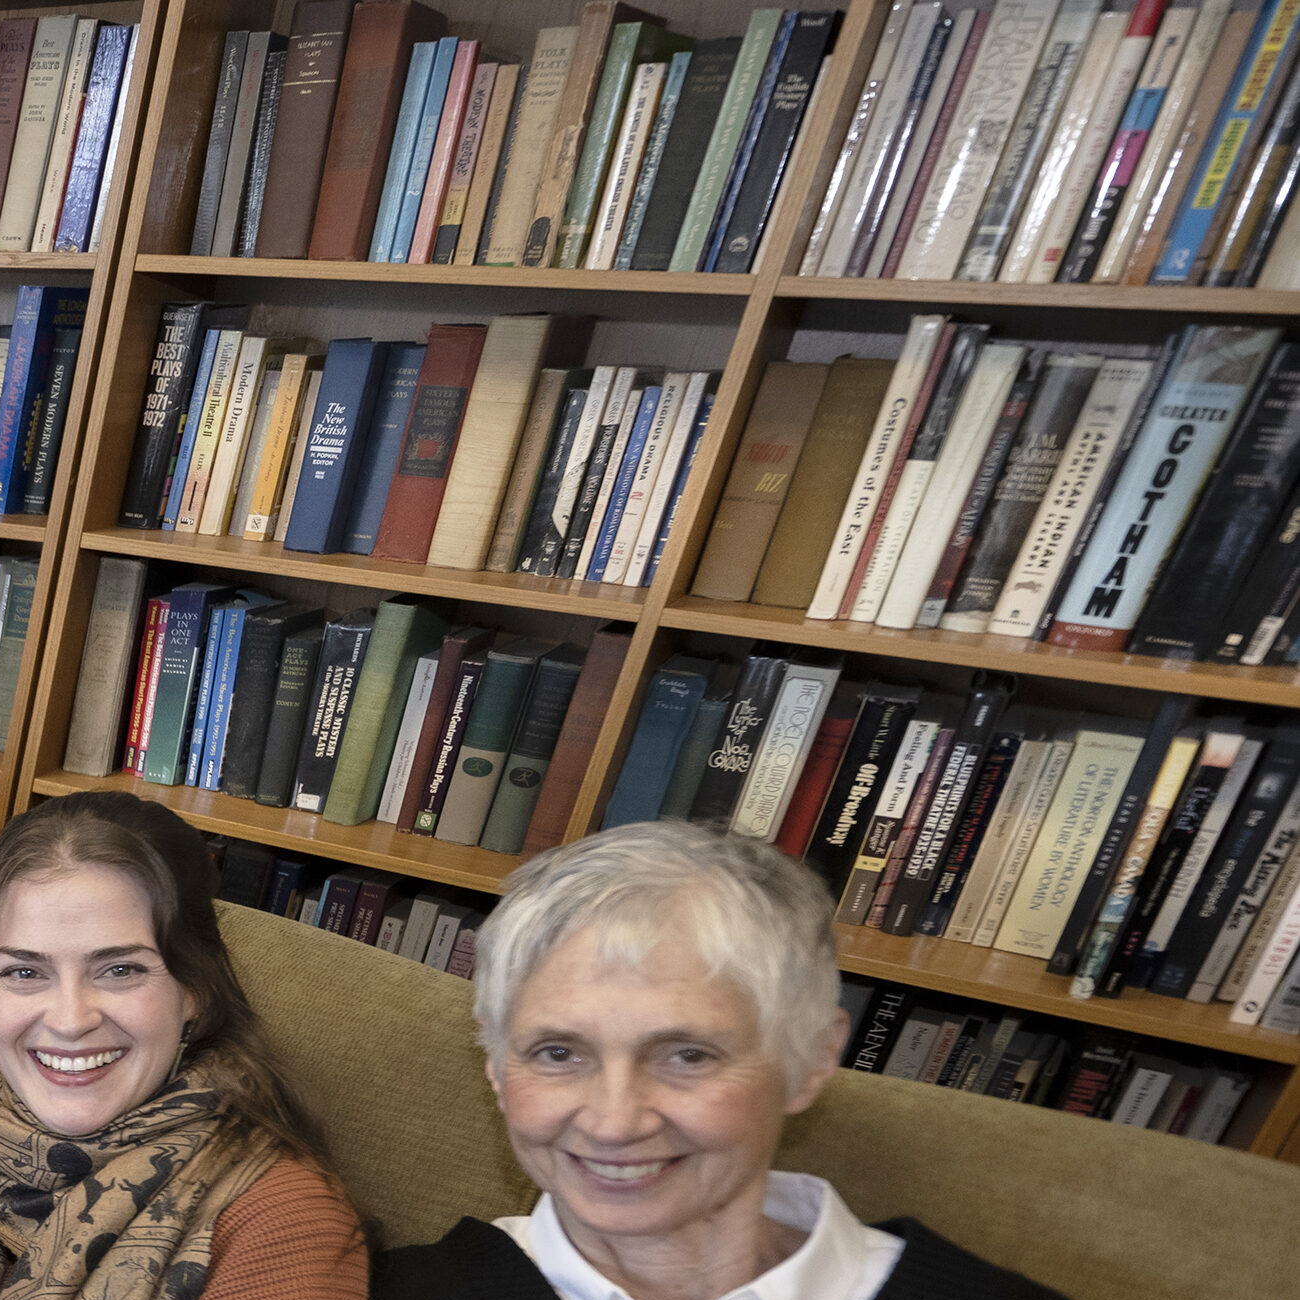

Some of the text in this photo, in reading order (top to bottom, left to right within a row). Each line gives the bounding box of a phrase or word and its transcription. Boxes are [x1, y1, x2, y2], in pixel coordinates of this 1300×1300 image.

[75, 31, 87, 57] Drama
[30, 61, 60, 70] PLAYS
[71, 66, 79, 79] the
[63, 81, 76, 110] Modern
[58, 111, 70, 134] World
[164, 325, 186, 342] THE
[156, 343, 185, 360] BEST
[3, 336, 30, 406] AMERICAN
[151, 360, 182, 378] PLAYS
[211, 341, 233, 401] Multicultural
[155, 377, 169, 394] OF
[147, 393, 173, 411] 1971-
[203, 399, 220, 430] Theatre
[224, 362, 254, 443] Modern Drama
[327, 401, 346, 414] The
[652, 384, 676, 441] RELIGIOUS
[32, 363, 65, 484] SEVEN MODERN PLAYS
[142, 410, 165, 428] 1972
[313, 424, 348, 436] British
[320, 413, 345, 425] New
[310, 434, 345, 446] Drama
[618, 454, 638, 497] ANTHOLOGY
[638, 444, 657, 482] DRAMA
[837, 394, 908, 558] Costumes of the East
[754, 472, 788, 493] BIZ
[1037, 430, 1105, 571] AMERICAN INDIAN
[606, 507, 620, 535] ROMAN
[1082, 422, 1195, 620] GOTHAM
[598, 534, 613, 560] DRAMA
[169, 610, 199, 621] PLAYS
[177, 619, 189, 630] IN
[229, 611, 238, 627] The
[144, 640, 152, 653] Best
[170, 636, 190, 646] ACT
[171, 628, 192, 638] ONE
[226, 628, 235, 645] Best
[284, 658, 310, 666] PLAYS
[349, 632, 363, 664] RICHARDS
[140, 654, 150, 682] American
[145, 632, 164, 717] The Best American Short Plays
[219, 647, 232, 683] American
[137, 682, 145, 697] Short
[217, 682, 226, 702] Short
[317, 682, 329, 707] MODERN
[134, 697, 143, 713] Plays
[212, 703, 223, 723] Plays
[313, 664, 344, 758] AND SUSPENSE PLAYS
[324, 666, 355, 758] 10 CLASSIC MYSTERY
[727, 702, 764, 731] Lyrics
[741, 698, 758, 716] The
[310, 707, 323, 736] THEATRE
[426, 672, 475, 795] Nineteenth-Century Russian Plays
[734, 726, 746, 744] of
[187, 752, 197, 781] APPLAUSE
[204, 758, 214, 788] APPLAUSE
[751, 681, 819, 837] THE NOEL COWARD DIARIES
[885, 722, 929, 815] Feeling And Form
[946, 753, 979, 813] BLUEPRINTS
[825, 759, 882, 849] Off-Broadway
[905, 743, 966, 878] FEDERAL THEATRE 1935-1939
[876, 820, 897, 848] Susanne
[938, 811, 955, 832] FOR
[1093, 792, 1138, 879] DEAR FRIENDS
[867, 821, 887, 852] Langer
[1028, 762, 1097, 913] OF LITERATURE BY WOMEN
[1044, 764, 1119, 909] THE NORTON ANTHOLOGY
[921, 840, 944, 873] BLACK
[873, 986, 906, 1026] THE
[936, 1025, 956, 1055] WOMEN
